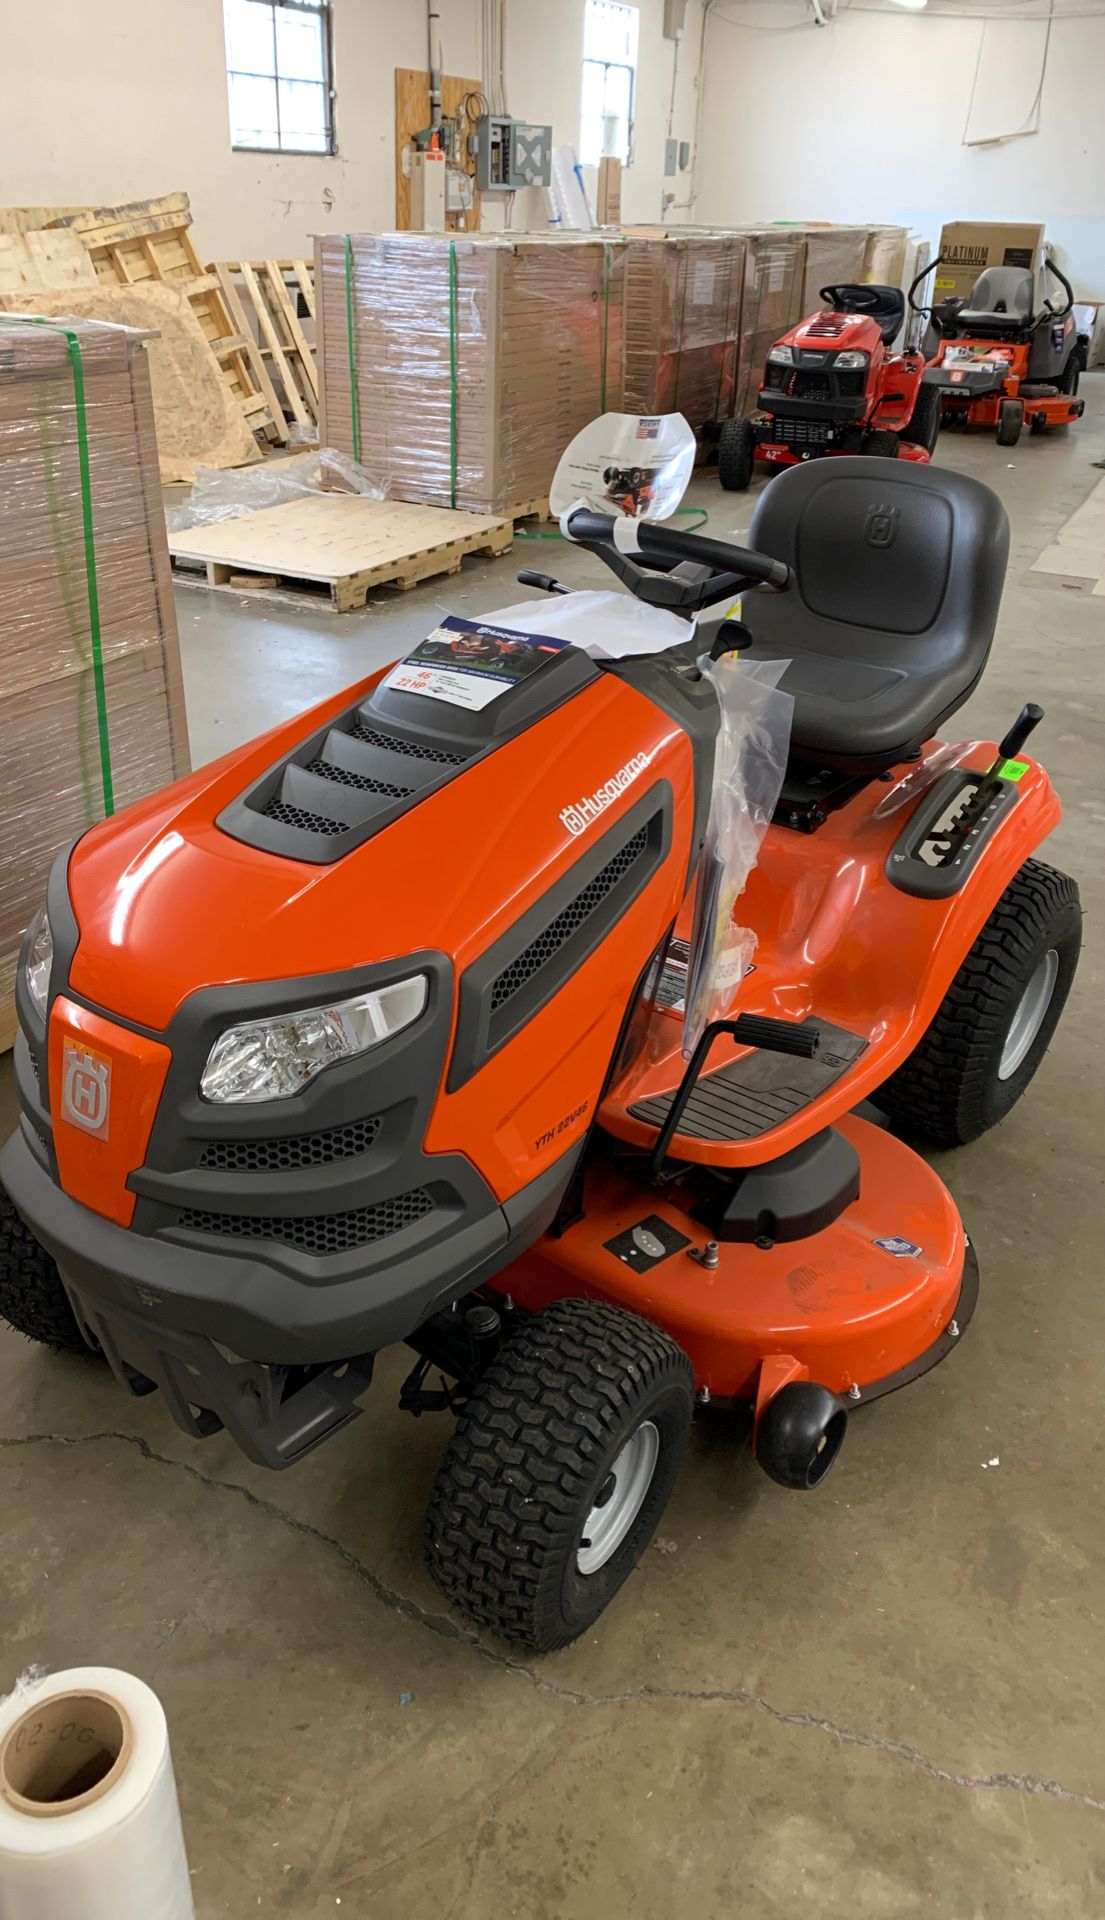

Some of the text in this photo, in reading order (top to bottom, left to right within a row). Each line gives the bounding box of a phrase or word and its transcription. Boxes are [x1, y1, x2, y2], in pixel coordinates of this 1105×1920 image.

[942, 245, 989, 259] PLATINUM
[397, 677, 410, 687] 22
[411, 680, 427, 690] HP
[576, 752, 649, 821] Husqvarna
[535, 1128, 555, 1150] YTH
